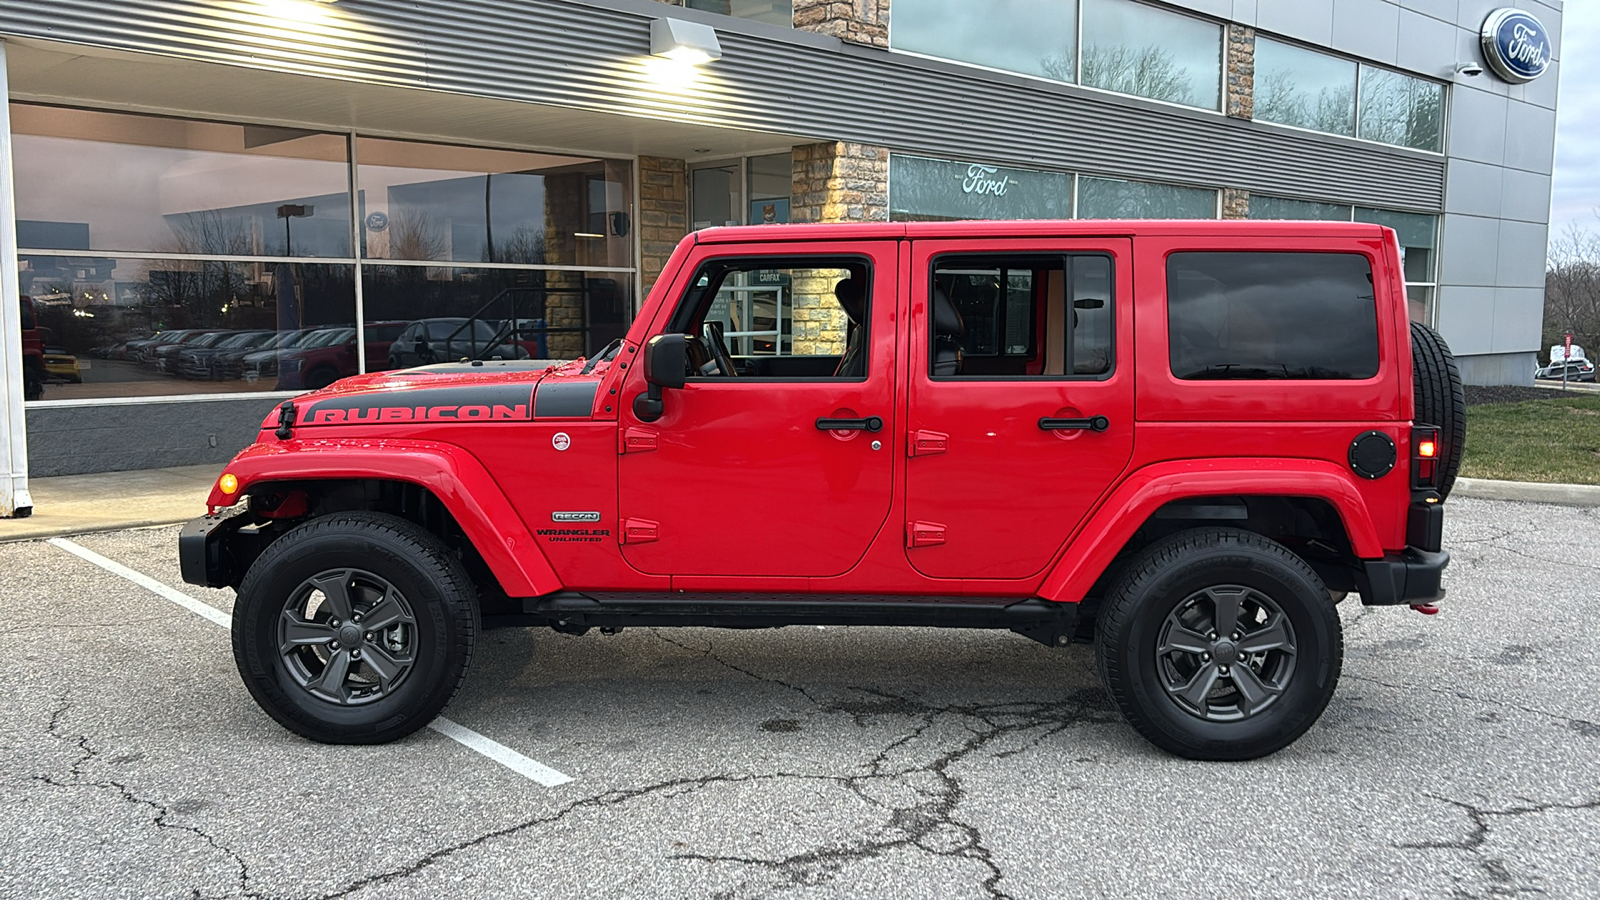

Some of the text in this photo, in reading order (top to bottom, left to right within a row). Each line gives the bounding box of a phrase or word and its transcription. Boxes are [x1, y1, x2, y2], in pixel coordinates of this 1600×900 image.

[1508, 23, 1545, 65] Ford
[963, 164, 1008, 196] Ford
[759, 273, 780, 282] CARFAX
[314, 405, 527, 422] RUBICON
[536, 529, 611, 537] WRANGLER
